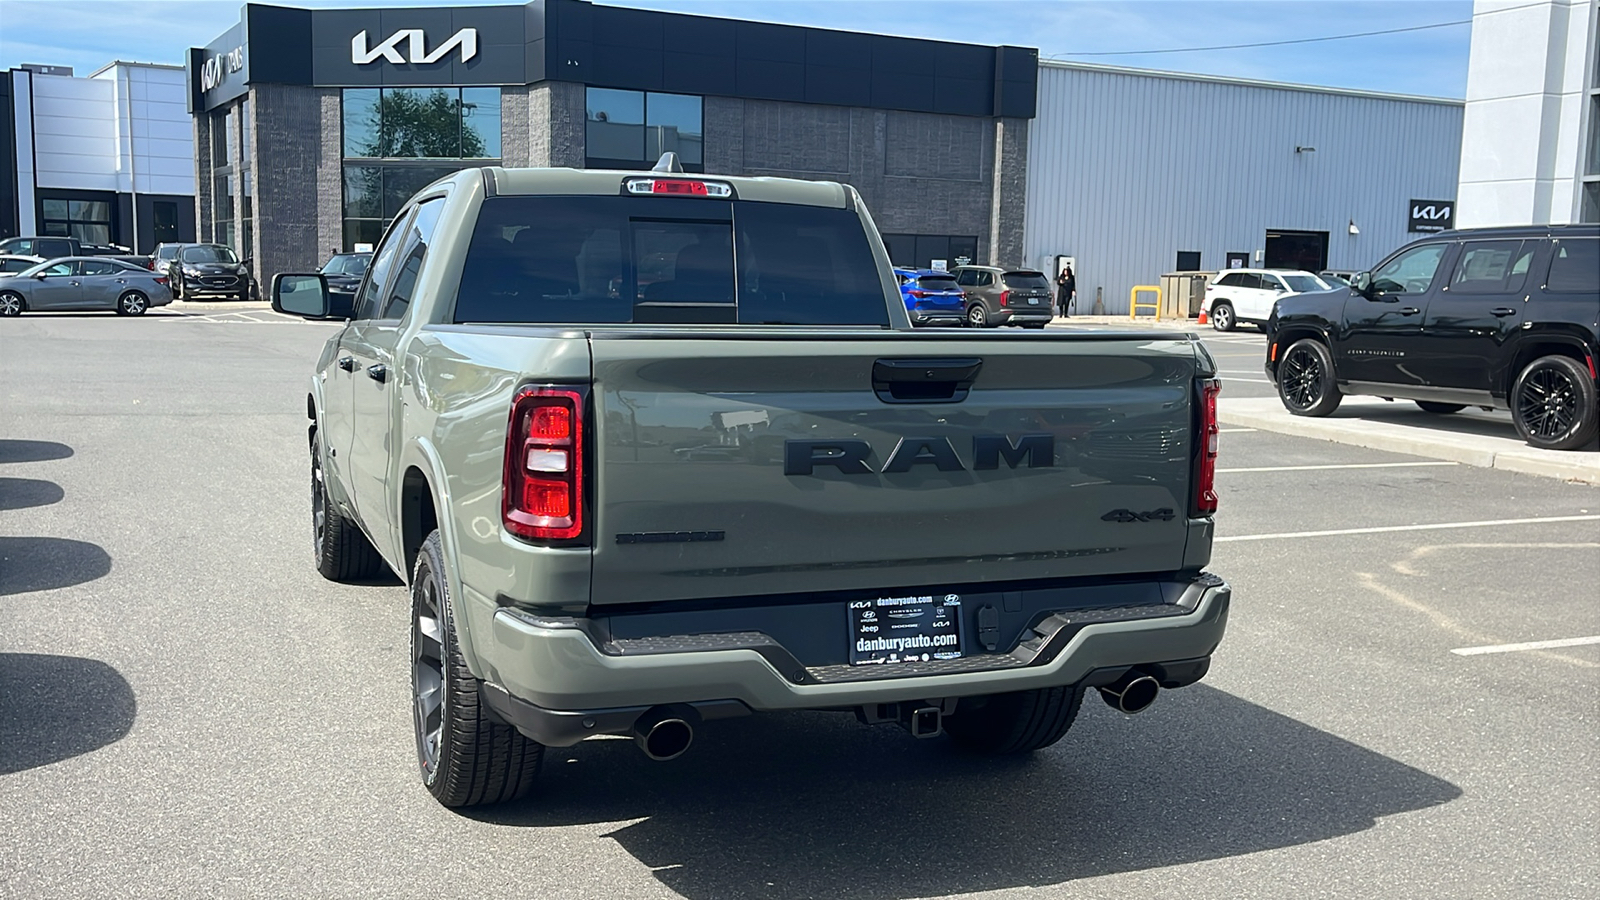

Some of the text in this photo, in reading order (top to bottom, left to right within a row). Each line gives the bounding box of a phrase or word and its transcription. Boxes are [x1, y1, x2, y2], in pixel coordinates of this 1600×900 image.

[352, 28, 477, 64] KIA
[1413, 205, 1450, 220] KIA
[784, 434, 1055, 476] RAM
[850, 601, 871, 609] KIA
[877, 596, 933, 607] danburyauto.com
[860, 625, 879, 633] Jeep
[856, 634, 957, 652] danburyauto.com
